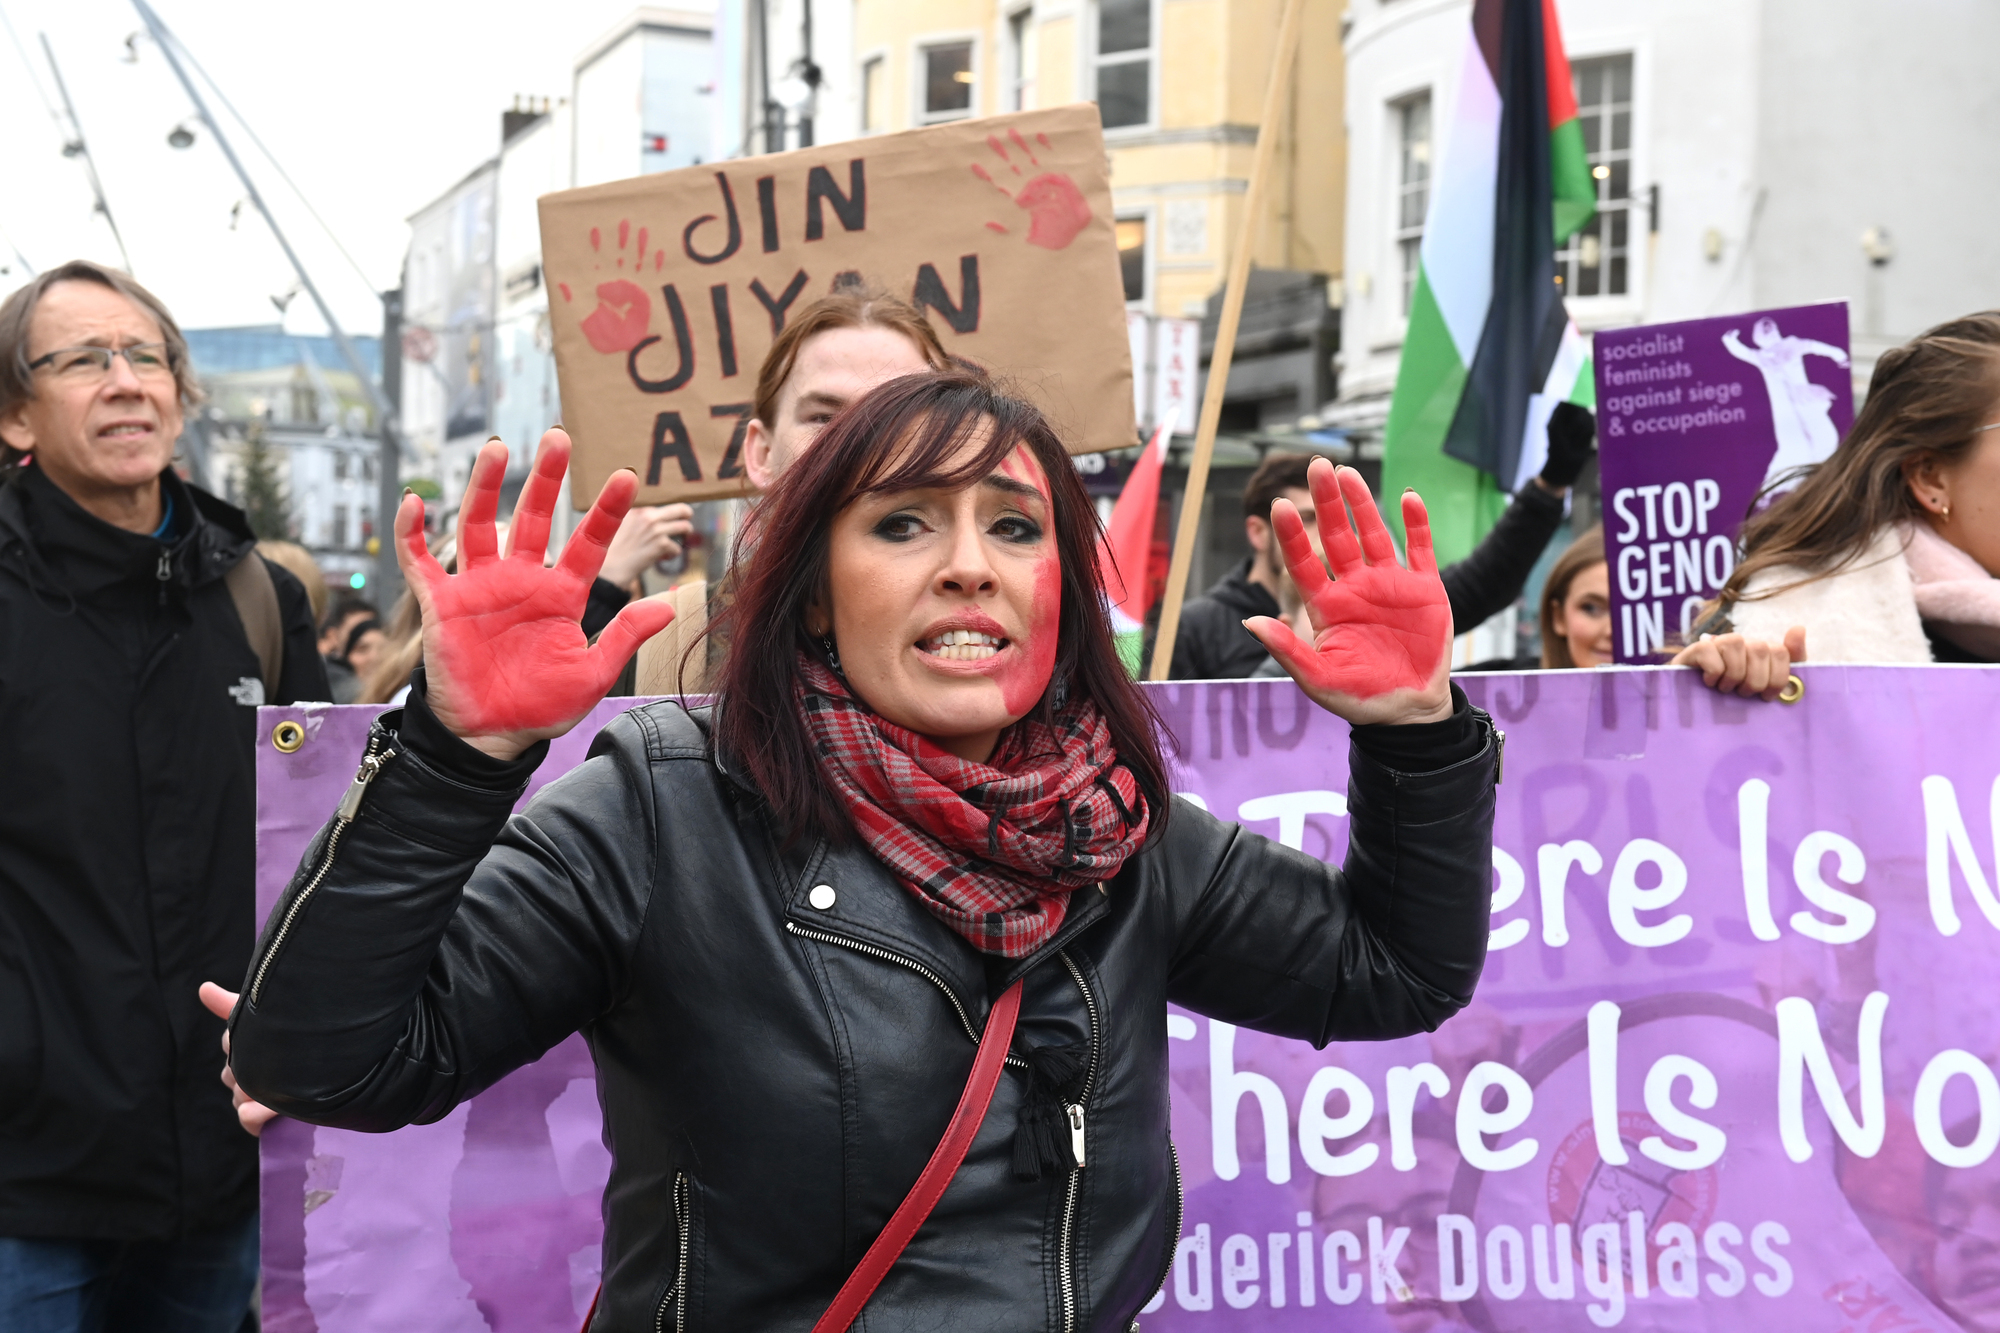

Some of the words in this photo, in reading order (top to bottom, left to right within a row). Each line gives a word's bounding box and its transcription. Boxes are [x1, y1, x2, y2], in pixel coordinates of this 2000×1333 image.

[683, 158, 866, 265] JIN
[627, 253, 981, 394] JIYN
[1603, 333, 1684, 362] socialist
[1604, 359, 1693, 387] feminists
[1606, 386, 1682, 416] against
[1688, 381, 1743, 405] siege
[1608, 416, 1626, 437] &
[1632, 404, 1746, 435] occupation
[1613, 478, 1720, 544] STOP
[1617, 534, 1747, 601] GENO
[1621, 600, 1664, 659] IN
[1737, 777, 1877, 945] Is
[1921, 774, 2000, 937] N
[1167, 1013, 1539, 1185] here
[1587, 1000, 1728, 1171] Is
[1775, 990, 2000, 1169] No
[1140, 1211, 1414, 1314] derick
[1437, 1210, 1794, 1328] Douglass
